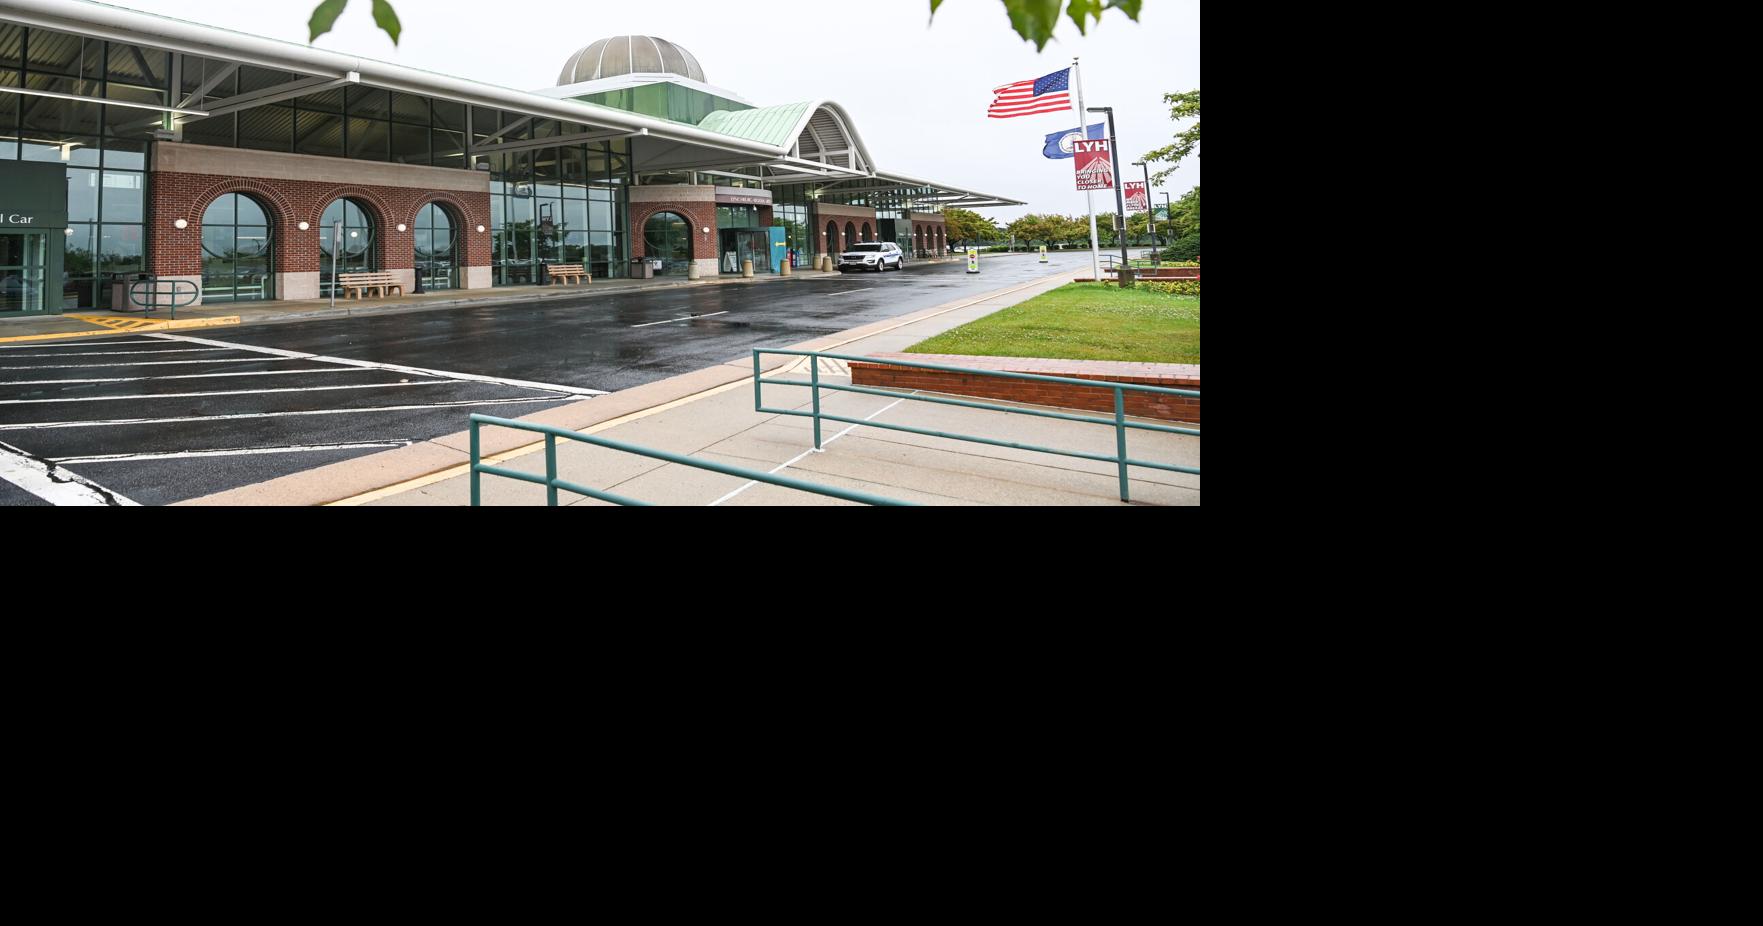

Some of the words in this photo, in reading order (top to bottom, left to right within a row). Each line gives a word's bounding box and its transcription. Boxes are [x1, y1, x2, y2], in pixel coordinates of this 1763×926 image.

[1074, 140, 1108, 153] LYH
[1124, 182, 1144, 190] LYH
[8, 214, 34, 224] Car
